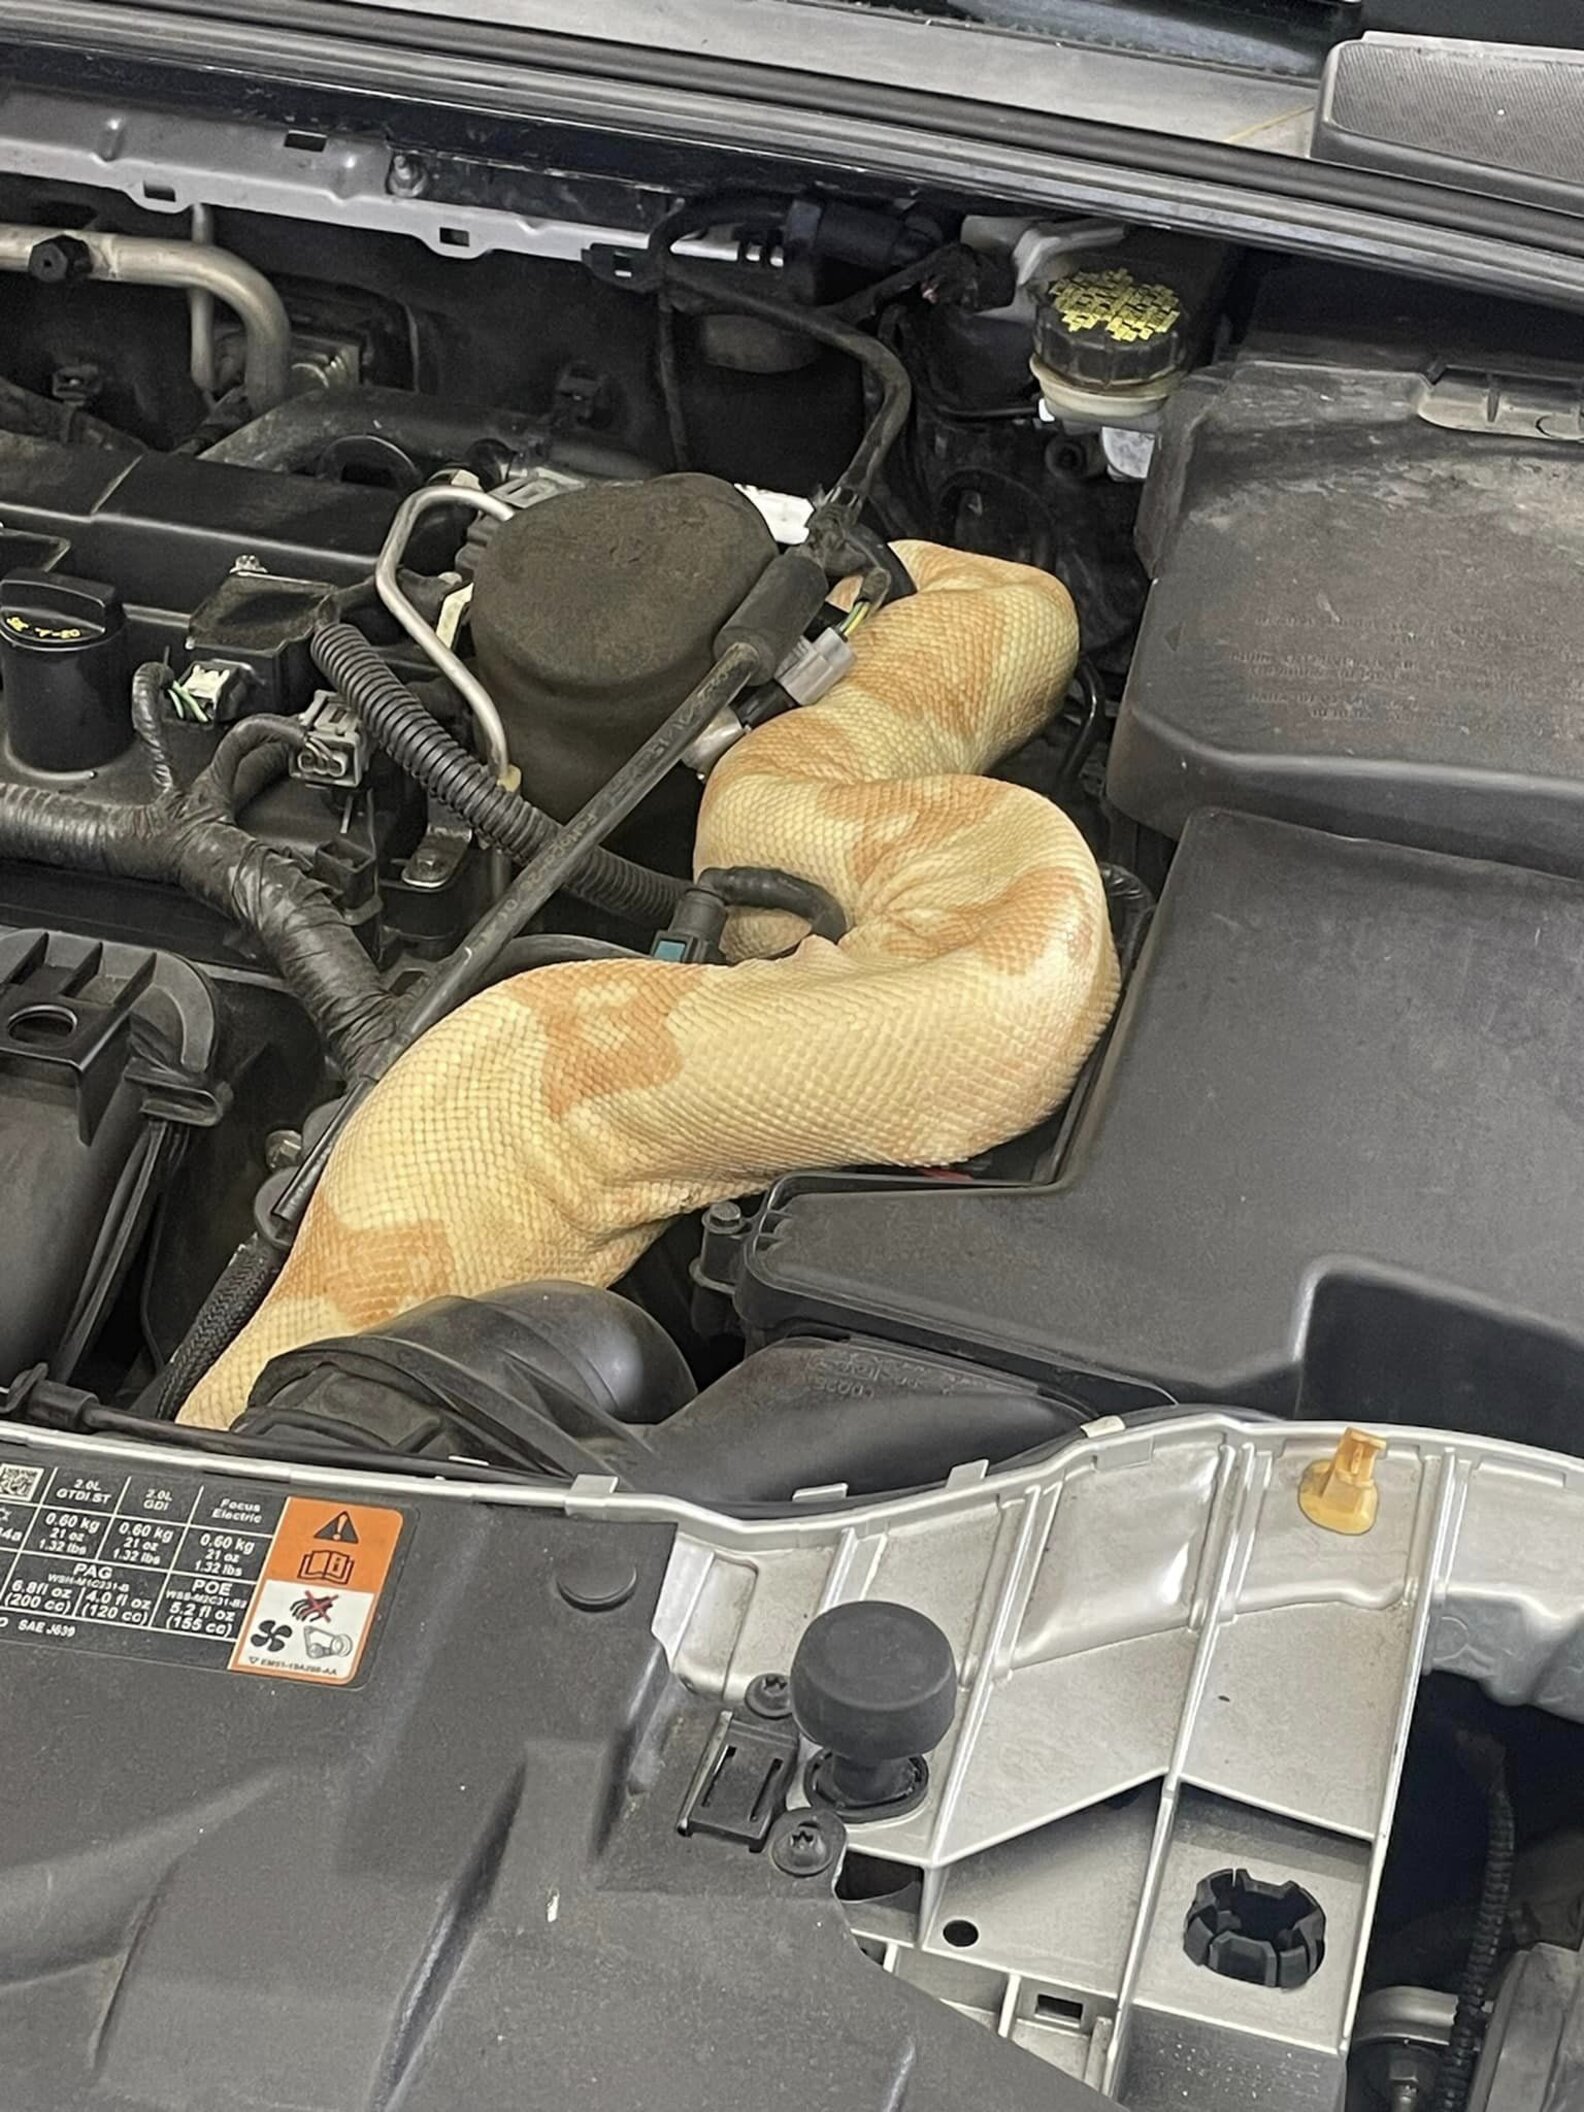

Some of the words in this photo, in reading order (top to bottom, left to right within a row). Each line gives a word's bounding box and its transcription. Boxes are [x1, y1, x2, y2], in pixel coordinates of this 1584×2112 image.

[74, 1479, 102, 1491] 2.0L
[91, 1492, 112, 1504] ST
[145, 1489, 173, 1502] 2.0L
[143, 1499, 170, 1511] GDI
[220, 1498, 261, 1512] Focus
[45, 1512, 78, 1528] 0.60
[80, 1517, 100, 1534] kg
[211, 1508, 262, 1523] Electric
[49, 1527, 66, 1539] 21
[68, 1532, 85, 1542] oz
[118, 1522, 151, 1537] 0.60
[153, 1527, 174, 1543] kg
[39, 1539, 66, 1552] 1.32
[66, 1543, 87, 1555] lbs
[123, 1537, 140, 1548] 21
[142, 1541, 159, 1551] oz
[200, 1533, 232, 1549] 0.60
[234, 1538, 255, 1555] kg
[113, 1548, 139, 1562] 1.32
[140, 1552, 161, 1565] lbs
[205, 1549, 221, 1560] 21
[223, 1553, 240, 1563] oz
[73, 1563, 113, 1580] PAG
[195, 1560, 221, 1574] 1.32
[222, 1565, 243, 1577] lbs
[51, 1588, 73, 1599] oz
[191, 1579, 233, 1596] POE
[4, 1592, 42, 1608] (200
[44, 1600, 72, 1615] cc)
[86, 1590, 112, 1604] 4.0
[115, 1594, 128, 1607] fl
[131, 1599, 152, 1610] oz
[81, 1602, 118, 1619] (120
[121, 1611, 149, 1626] cc)
[169, 1601, 196, 1616] 5.2
[198, 1605, 212, 1618] fl
[214, 1610, 236, 1622] oz
[18, 1619, 46, 1633] SAE
[166, 1615, 203, 1631] (155
[205, 1623, 233, 1637] cc)
